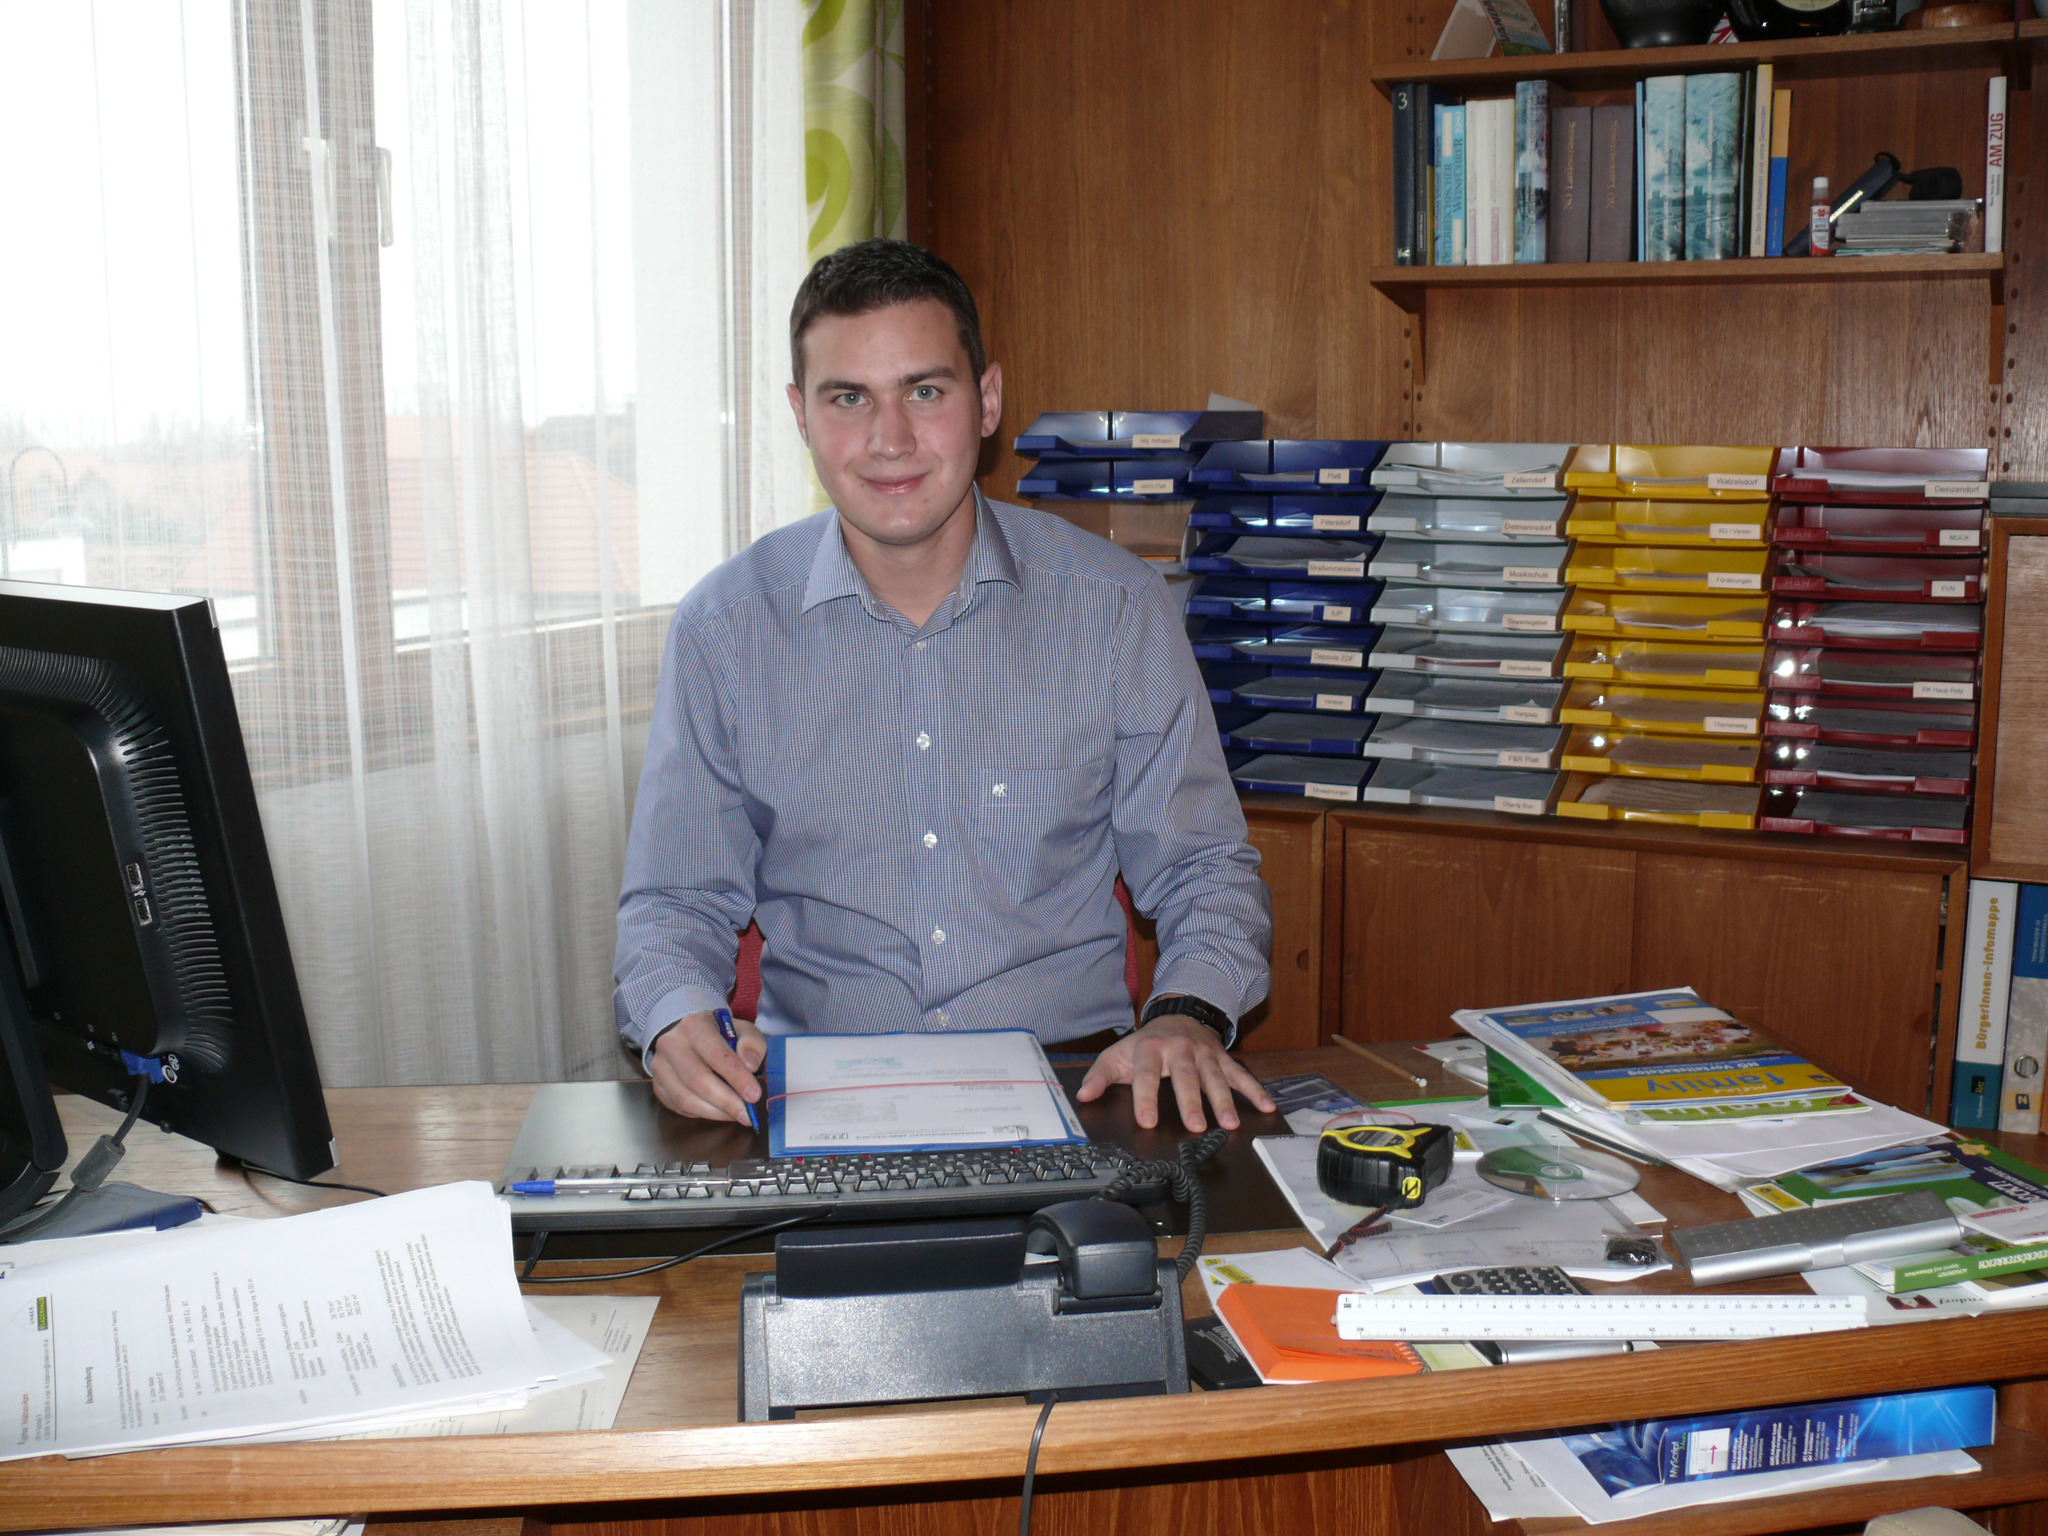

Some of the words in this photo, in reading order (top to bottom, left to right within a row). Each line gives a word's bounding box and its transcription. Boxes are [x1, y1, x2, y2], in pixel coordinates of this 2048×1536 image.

[1398, 92, 1408, 110] 3
[1990, 112, 2004, 141] ZUG
[1989, 144, 2003, 168] AM
[1327, 472, 1342, 480] Platt
[1511, 476, 1547, 484] Zellerndorf
[1716, 478, 1759, 486] Watzelsdorf
[1933, 485, 1981, 494] Deinzendorf
[1504, 522, 1553, 531] Dietmannsdorf
[1646, 1072, 1787, 1094] family
[1669, 1441, 1680, 1478] MyScript
